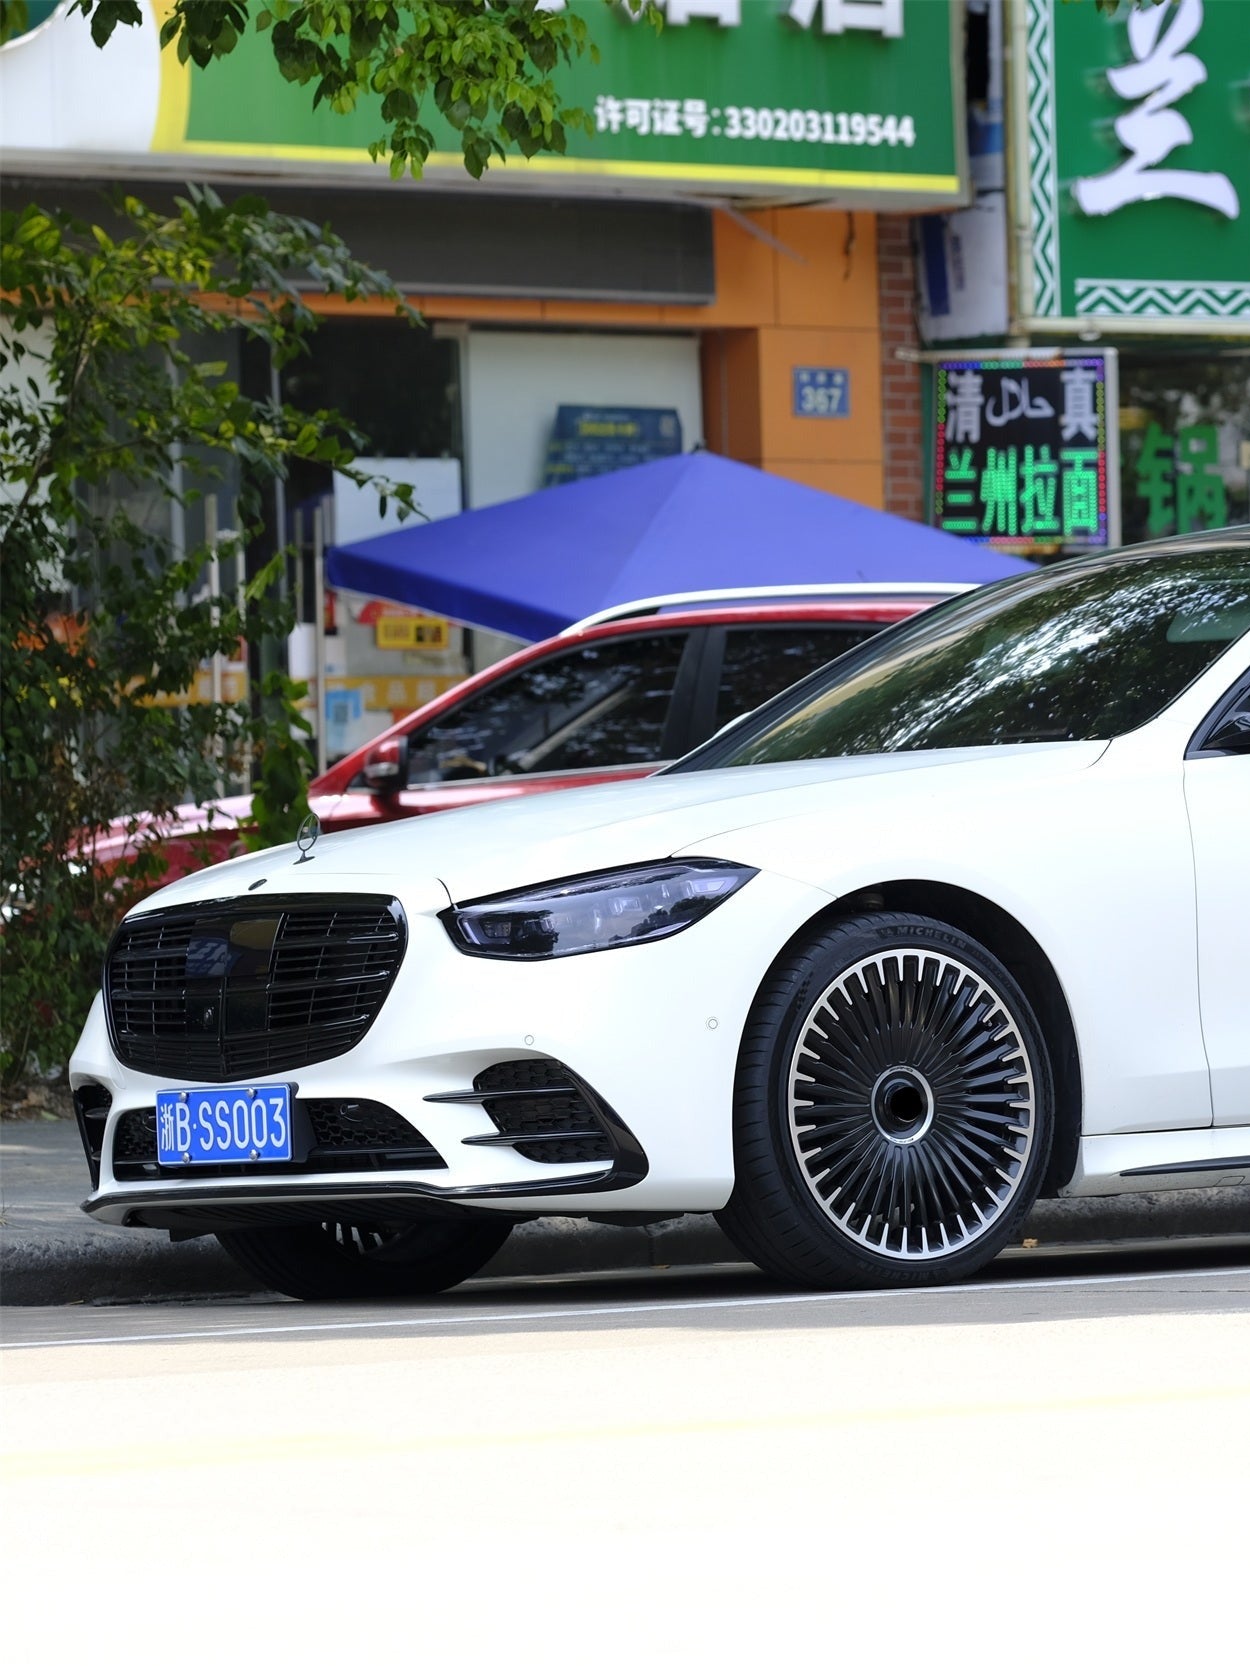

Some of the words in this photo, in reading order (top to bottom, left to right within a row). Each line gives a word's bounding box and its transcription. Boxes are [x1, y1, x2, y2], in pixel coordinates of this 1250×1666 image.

[942, 446, 1099, 537] 兰州拉面
[897, 926, 967, 950] MICHELIN
